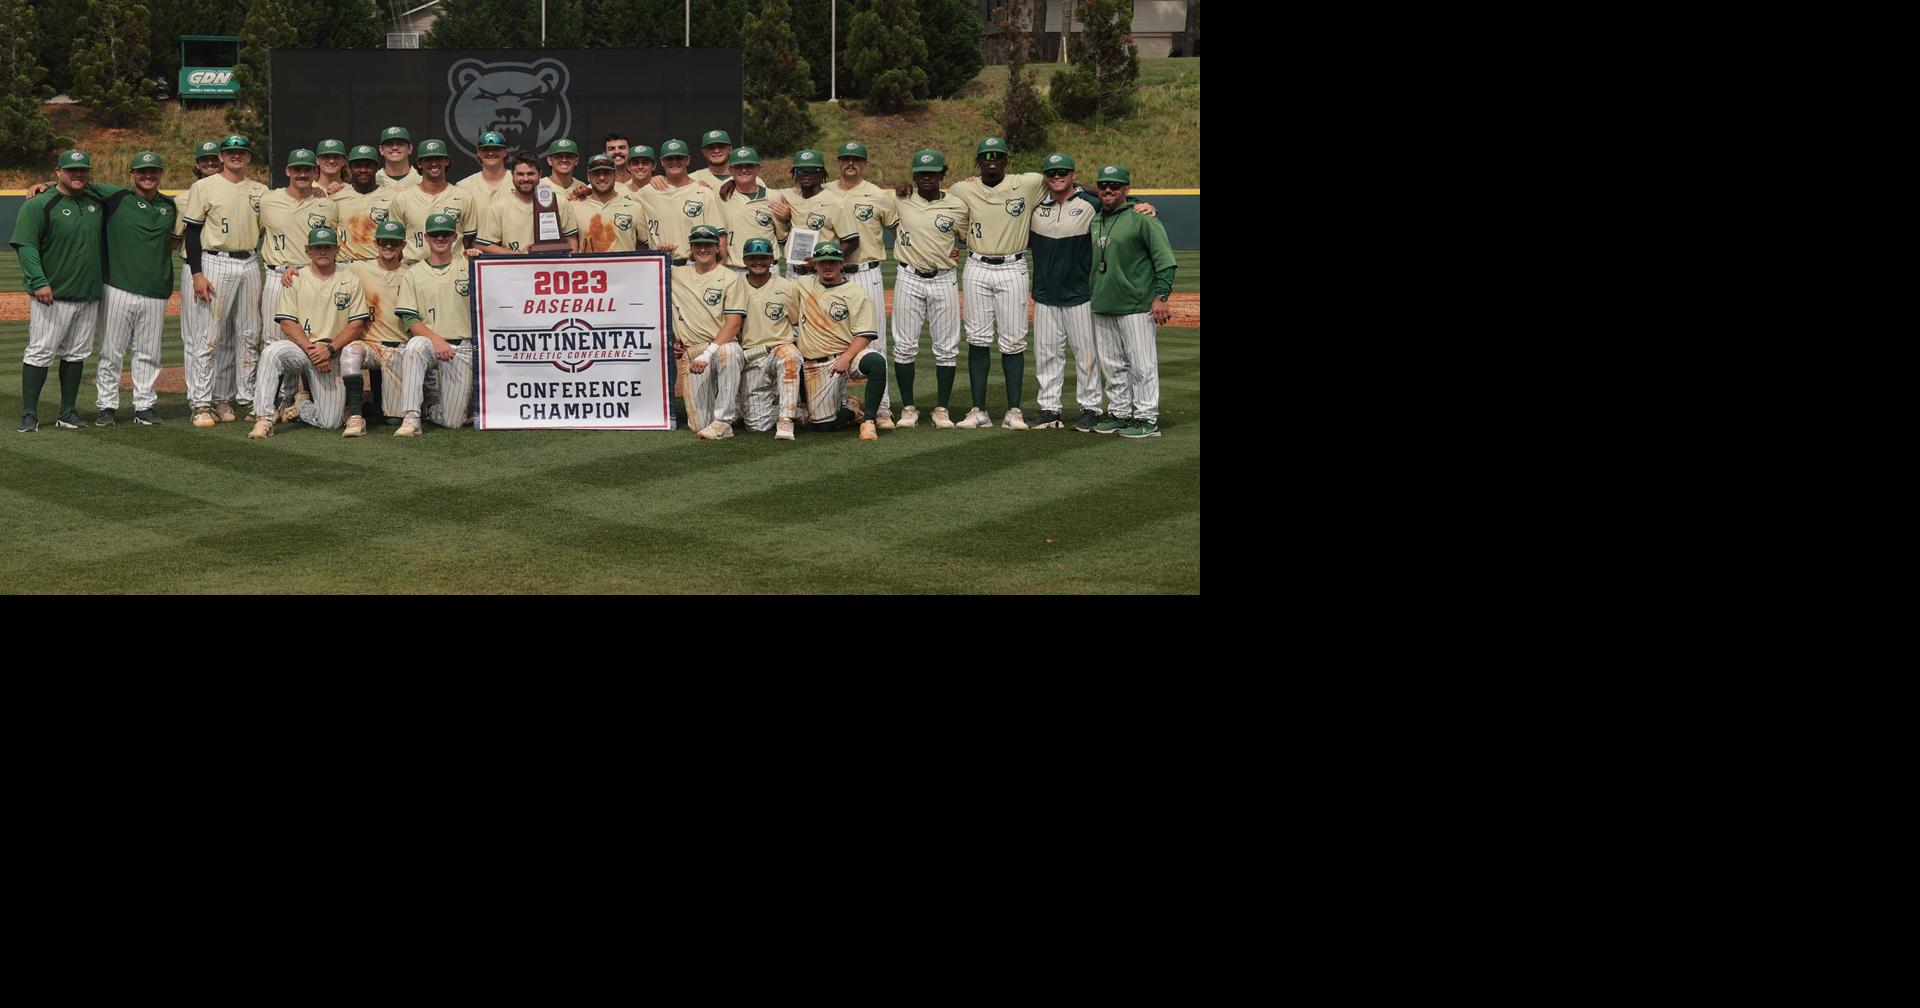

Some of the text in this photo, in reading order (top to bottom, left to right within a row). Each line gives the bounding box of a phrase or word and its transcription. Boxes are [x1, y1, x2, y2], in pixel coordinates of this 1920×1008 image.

[189, 71, 232, 85] GDN
[221, 217, 229, 234] 5
[534, 270, 608, 296] 2023
[523, 298, 616, 314] BASEBALL
[303, 318, 312, 334] 4
[493, 331, 652, 352] CONTINENTAL
[512, 350, 633, 360] ATHLETIC CONFERENCE
[506, 381, 642, 399] CONFERENCE
[519, 402, 630, 420] CHAMPION
